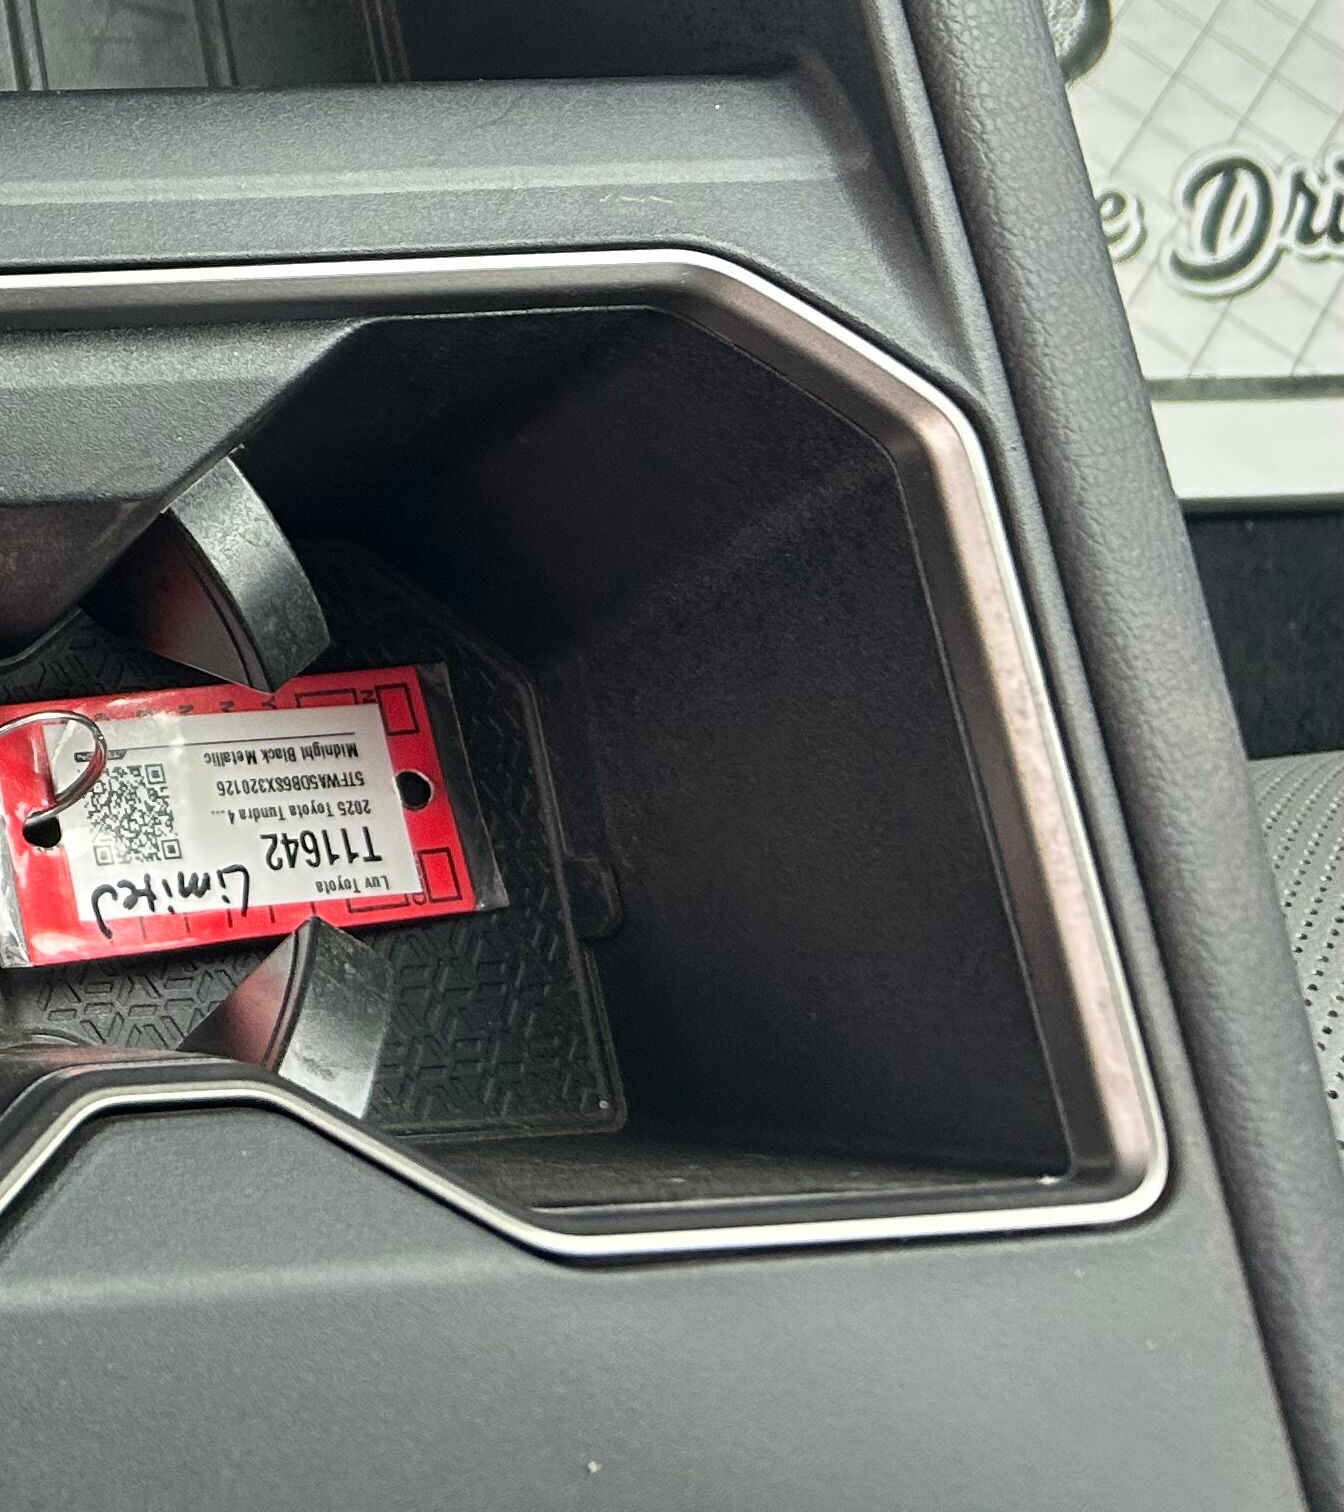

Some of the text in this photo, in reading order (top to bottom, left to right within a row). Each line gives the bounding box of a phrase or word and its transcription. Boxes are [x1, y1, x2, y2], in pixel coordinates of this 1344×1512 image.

[203, 741, 359, 767] Midnight Black Metallic
[238, 805, 285, 822] Tundra
[289, 802, 334, 819] Toyota
[337, 799, 371, 816] 2025
[260, 826, 382, 871] T11642
[315, 875, 390, 894] Luv Toyota
